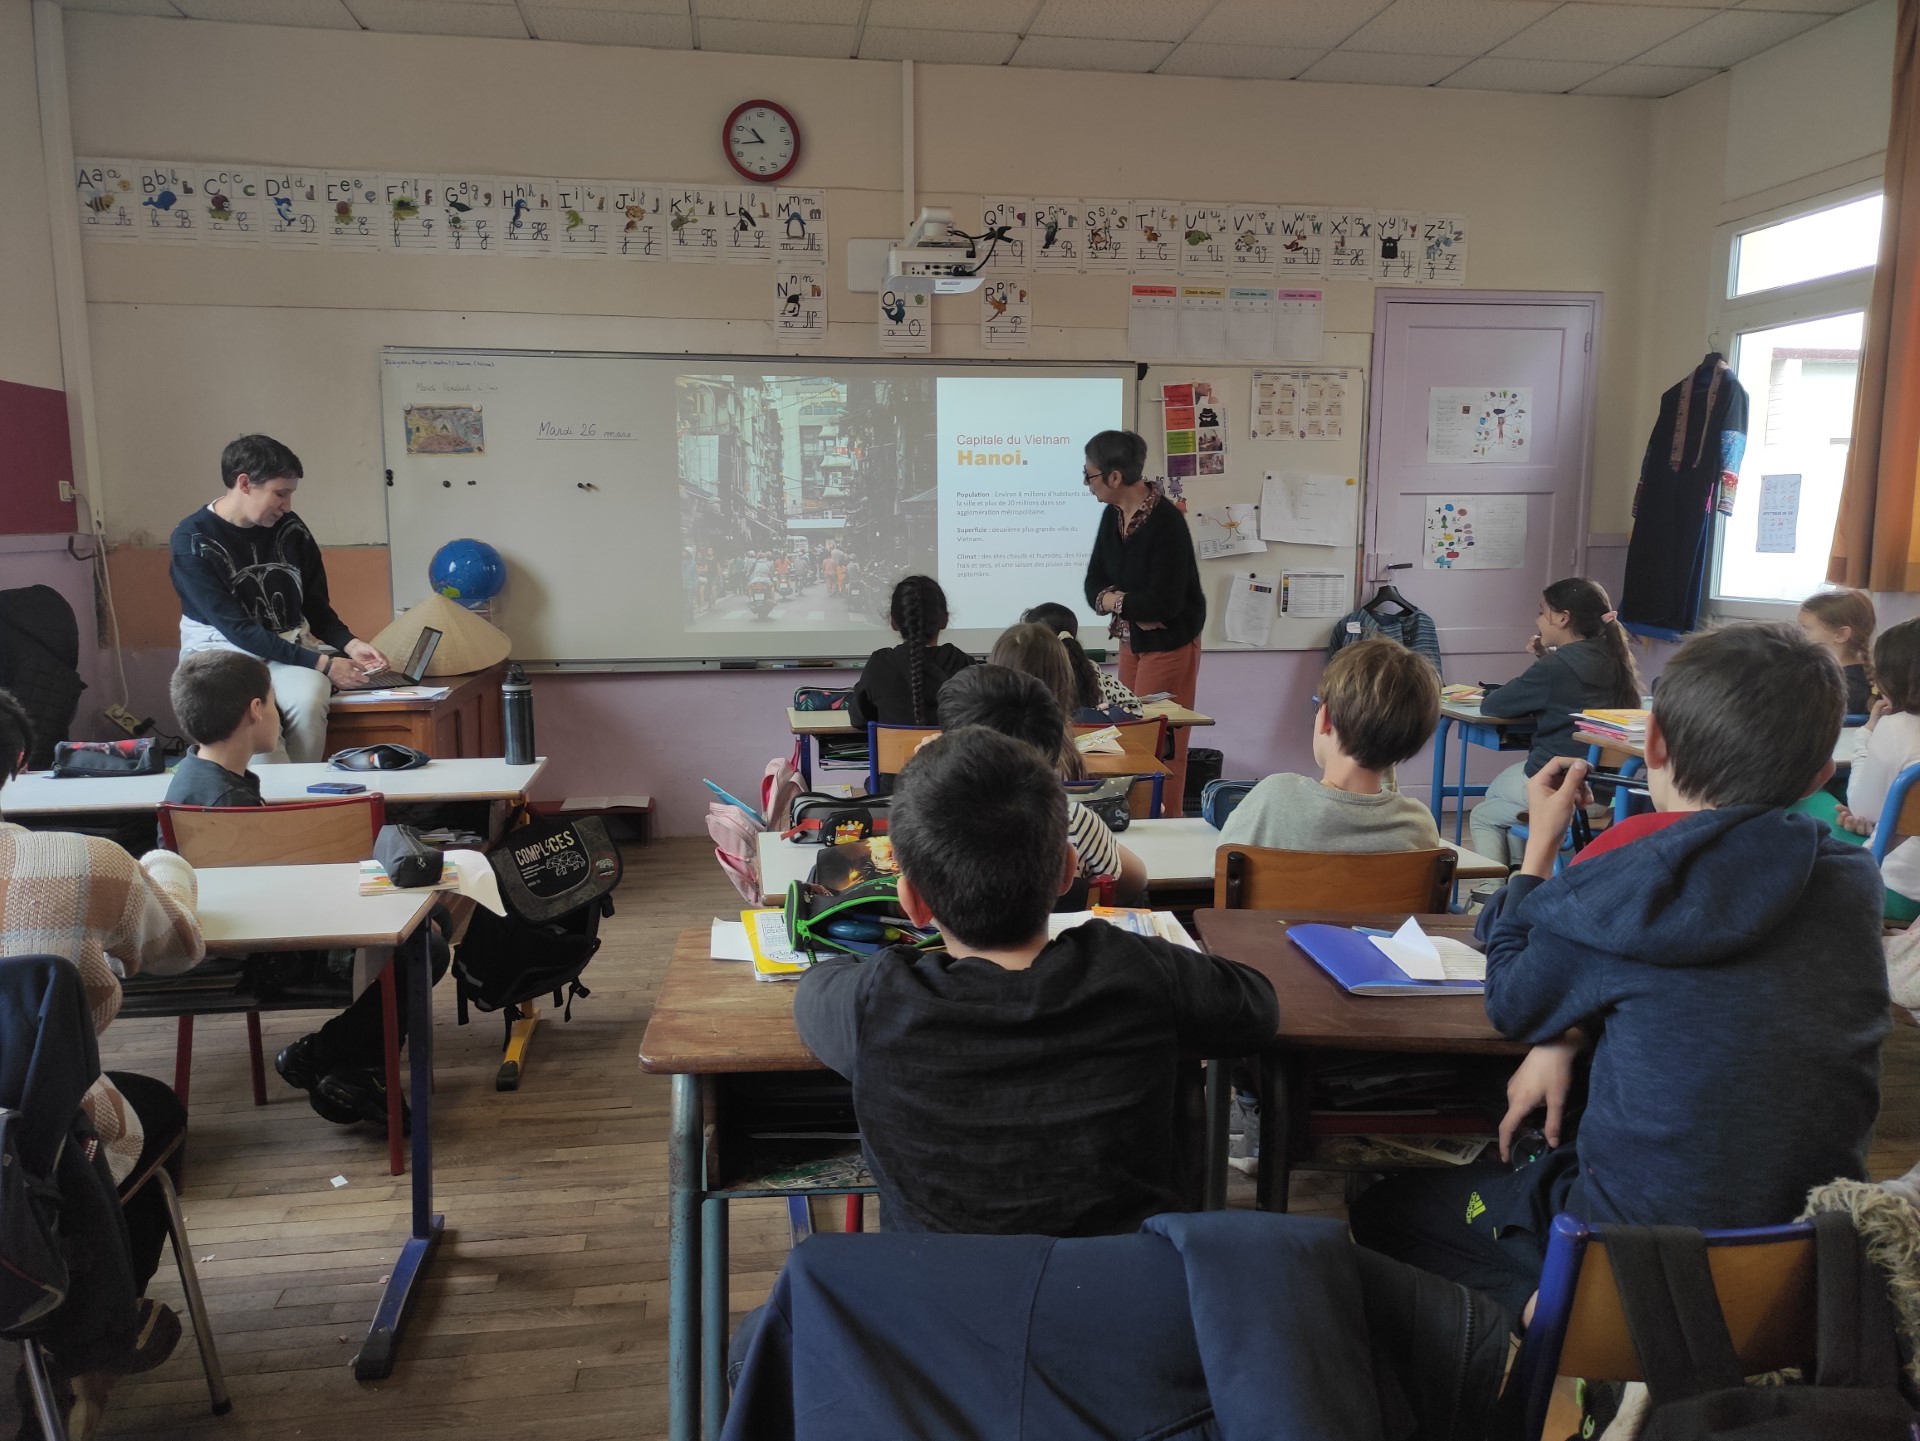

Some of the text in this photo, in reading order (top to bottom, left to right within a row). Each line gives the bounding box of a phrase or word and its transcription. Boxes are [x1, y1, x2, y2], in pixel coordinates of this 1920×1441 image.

[882, 291, 896, 306] O
[539, 421, 574, 436] Mardi
[580, 424, 596, 436] 26
[957, 435, 1070, 446] Capitale du Vietnam
[957, 450, 1028, 466] Hanoi.
[957, 509, 1000, 517] agglomération
[1035, 526, 1056, 534] grande
[1466, 1191, 1477, 1224] adidas
